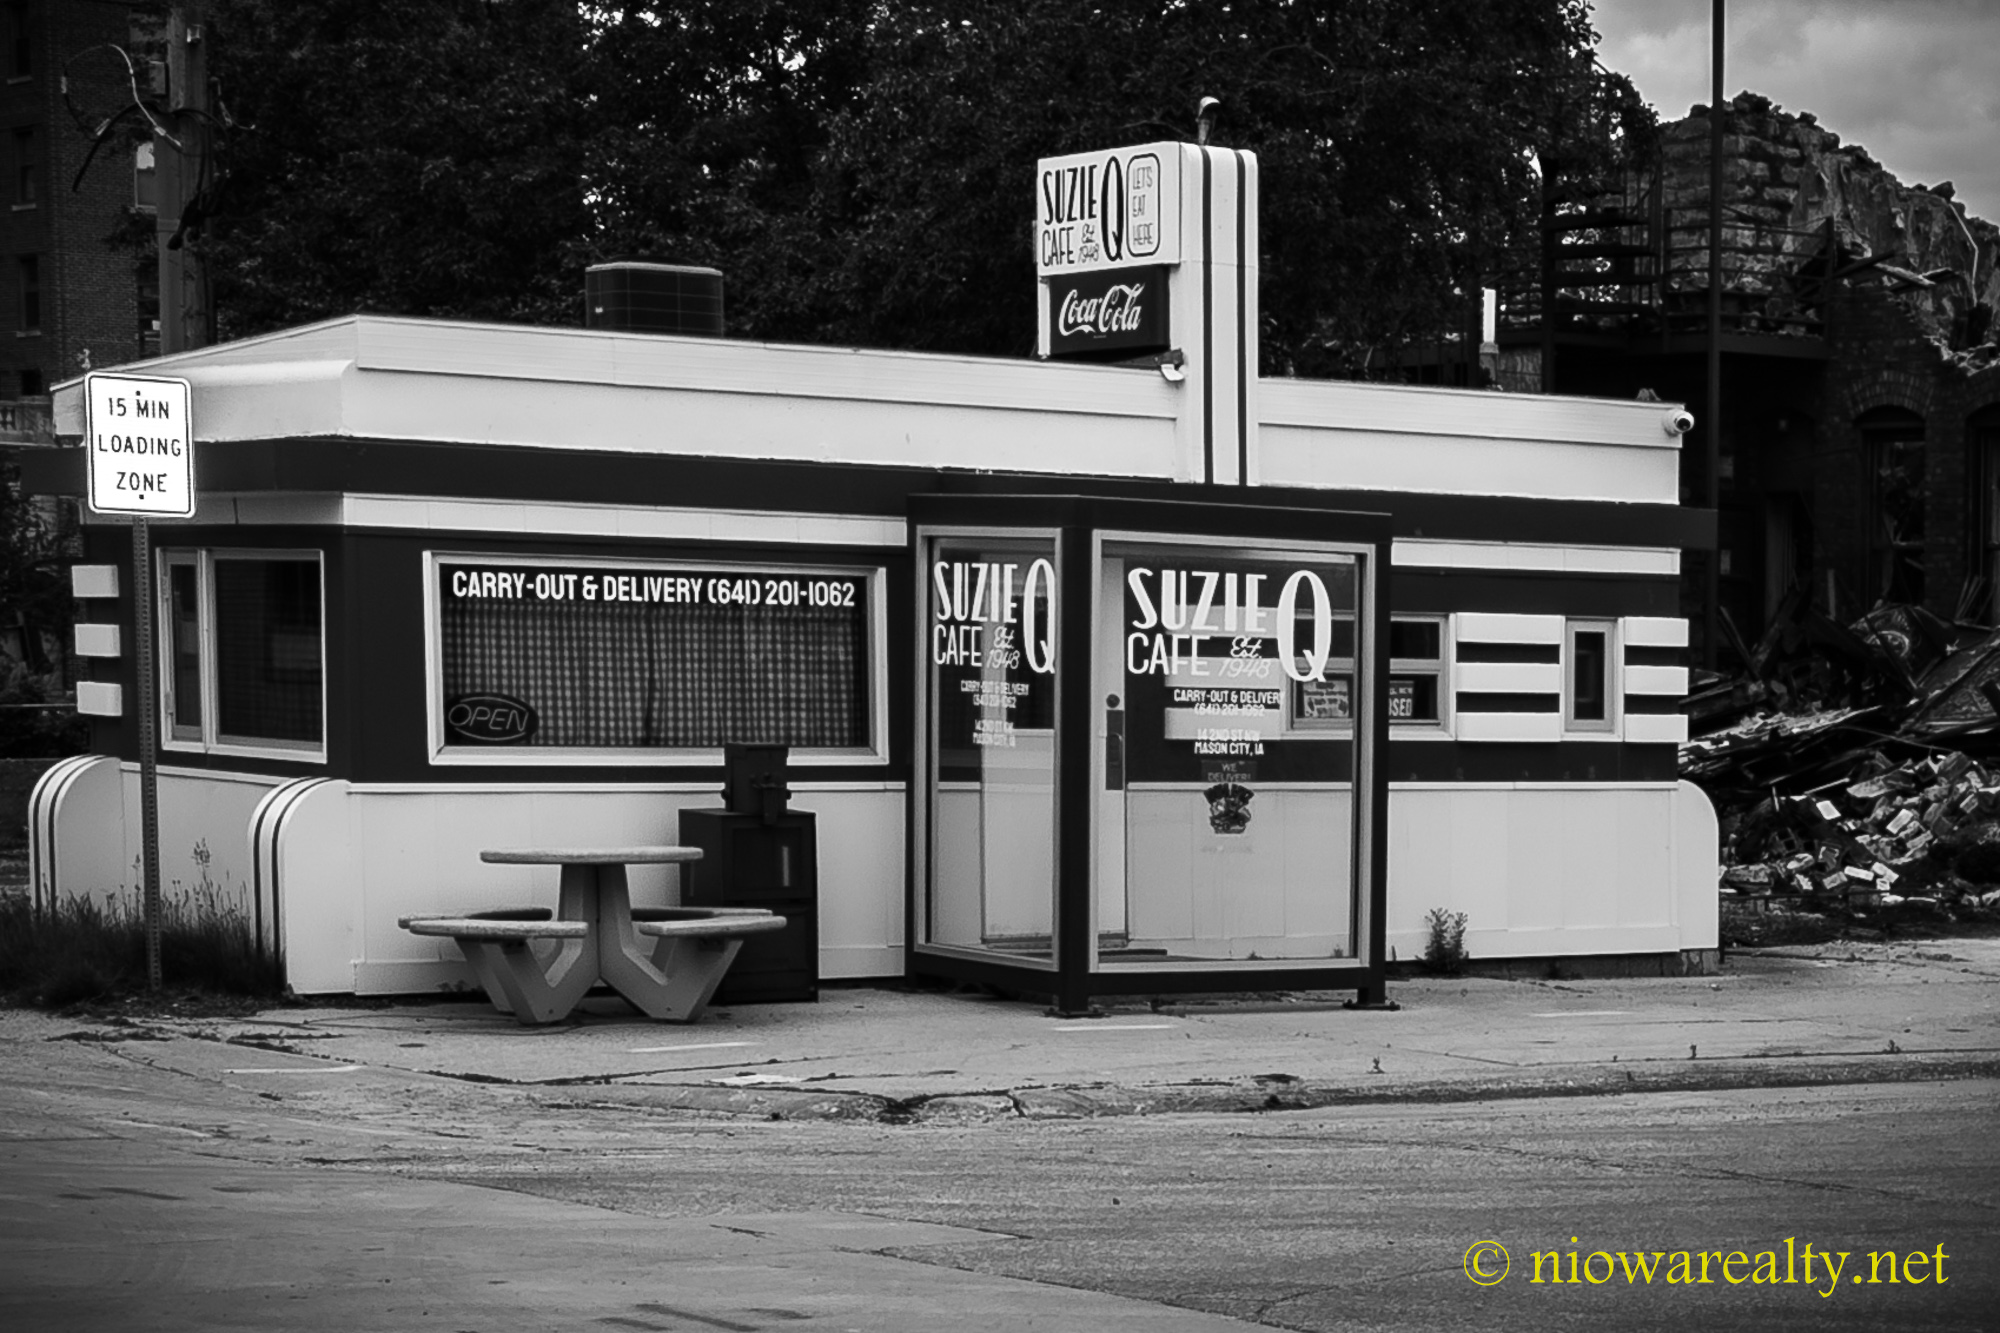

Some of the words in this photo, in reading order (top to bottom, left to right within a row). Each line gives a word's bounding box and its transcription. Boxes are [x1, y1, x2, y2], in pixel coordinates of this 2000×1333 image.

[1043, 164, 1098, 225] SUZIE
[1101, 156, 1125, 262] Q
[1132, 194, 1146, 218] EAT
[1042, 226, 1075, 267] CAFE
[1078, 243, 1100, 264] 1948
[108, 397, 127, 417] 15
[136, 399, 169, 419] MIN
[98, 434, 181, 457] LOADING
[116, 471, 167, 492] ZONE
[452, 570, 577, 600] CARRY-OUT
[582, 576, 598, 601] &
[603, 575, 703, 604] DELIVERY
[707, 578, 761, 604] (641)
[765, 579, 855, 607] 201-1062
[933, 561, 1018, 623] SUZIE
[1023, 558, 1056, 674] Q
[1128, 567, 1268, 633] SUZIE
[1277, 570, 1332, 683] Q
[933, 623, 983, 667] CAFE
[1127, 632, 1211, 676] CAFE
[986, 649, 1020, 670] 1948
[1217, 657, 1272, 679] 1948
[1173, 689, 1229, 702] CARRY-OUT
[1231, 690, 1239, 703] &
[1240, 690, 1285, 704] DELIVERY
[448, 703, 529, 732] OPEN
[1194, 741, 1228, 754] MASON
[1221, 762, 1237, 772] WE
